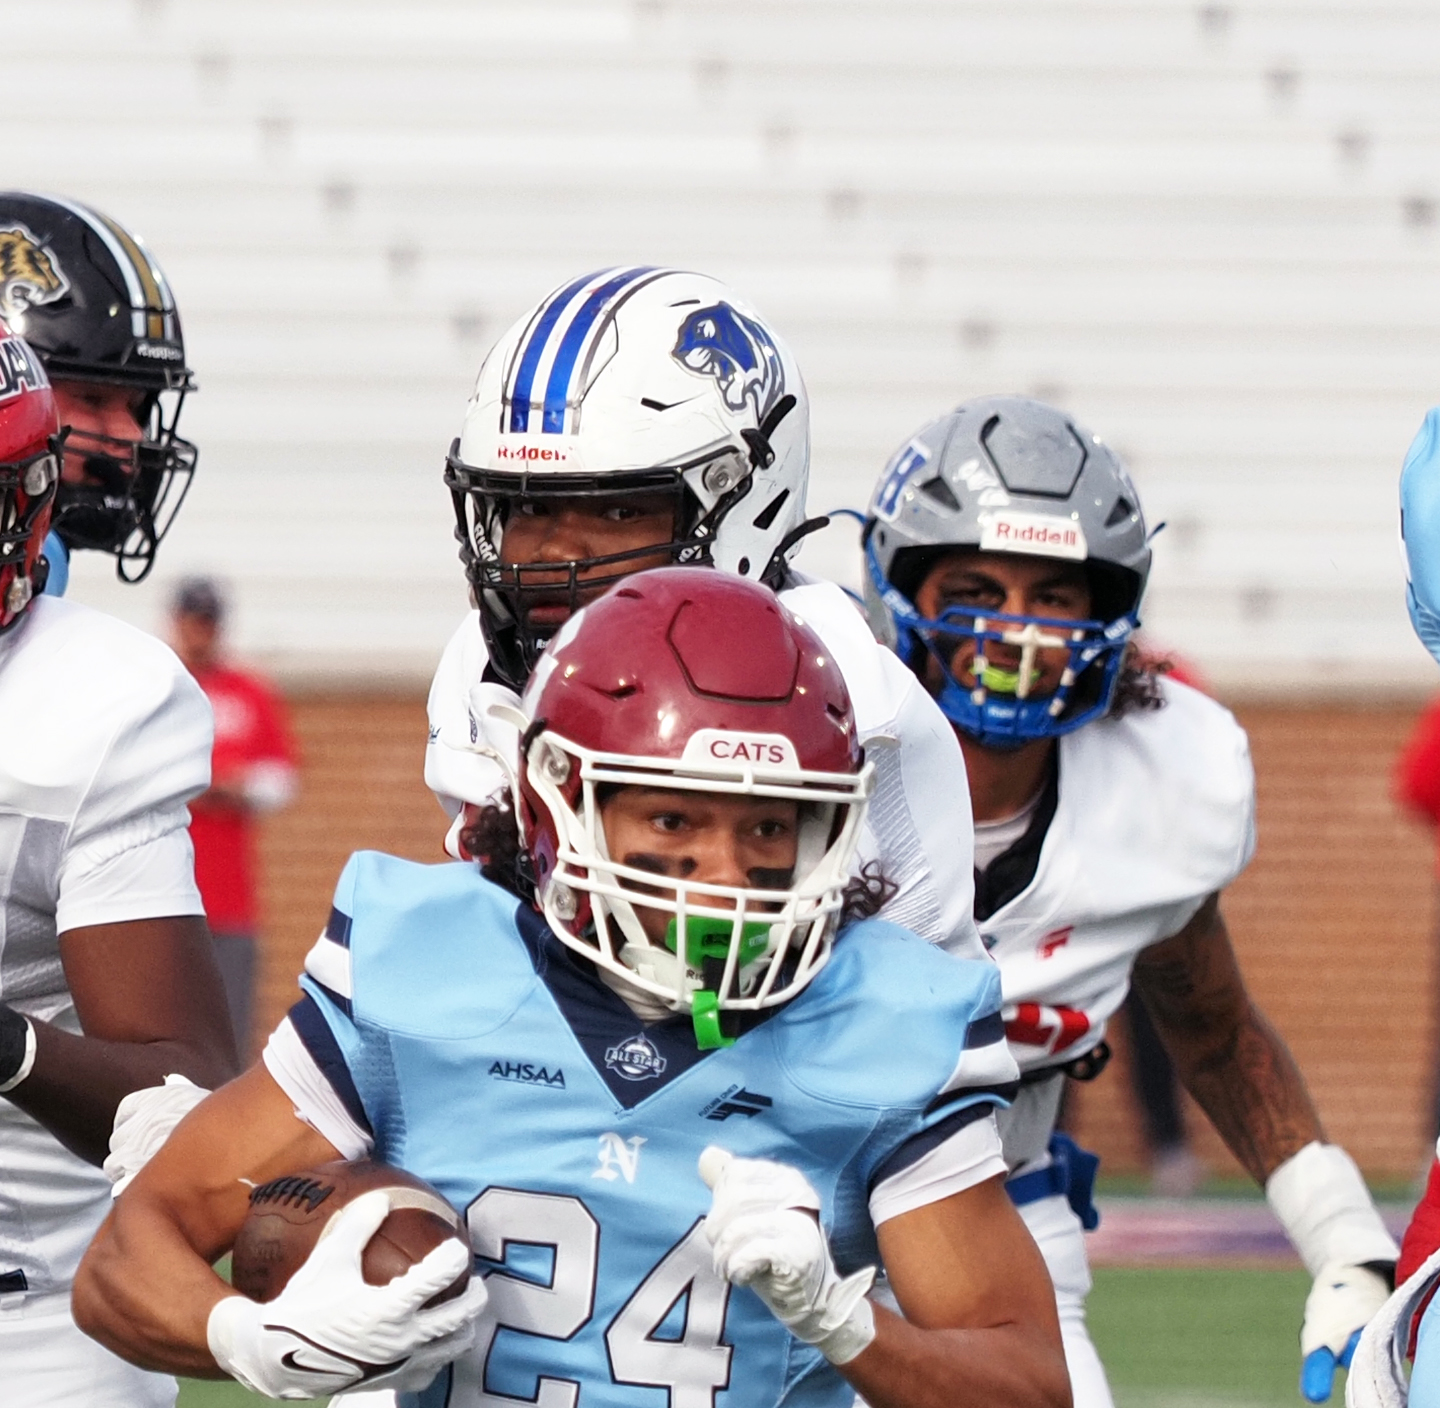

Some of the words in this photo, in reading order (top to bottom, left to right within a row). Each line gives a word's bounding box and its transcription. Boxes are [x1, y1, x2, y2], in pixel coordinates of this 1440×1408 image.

[995, 521, 1077, 546] Riddell
[710, 740, 785, 764] CATS
[610, 1050, 630, 1062] ALL
[632, 1054, 660, 1068] STAR
[488, 1060, 566, 1087] AHSAA
[591, 1132, 649, 1184] N
